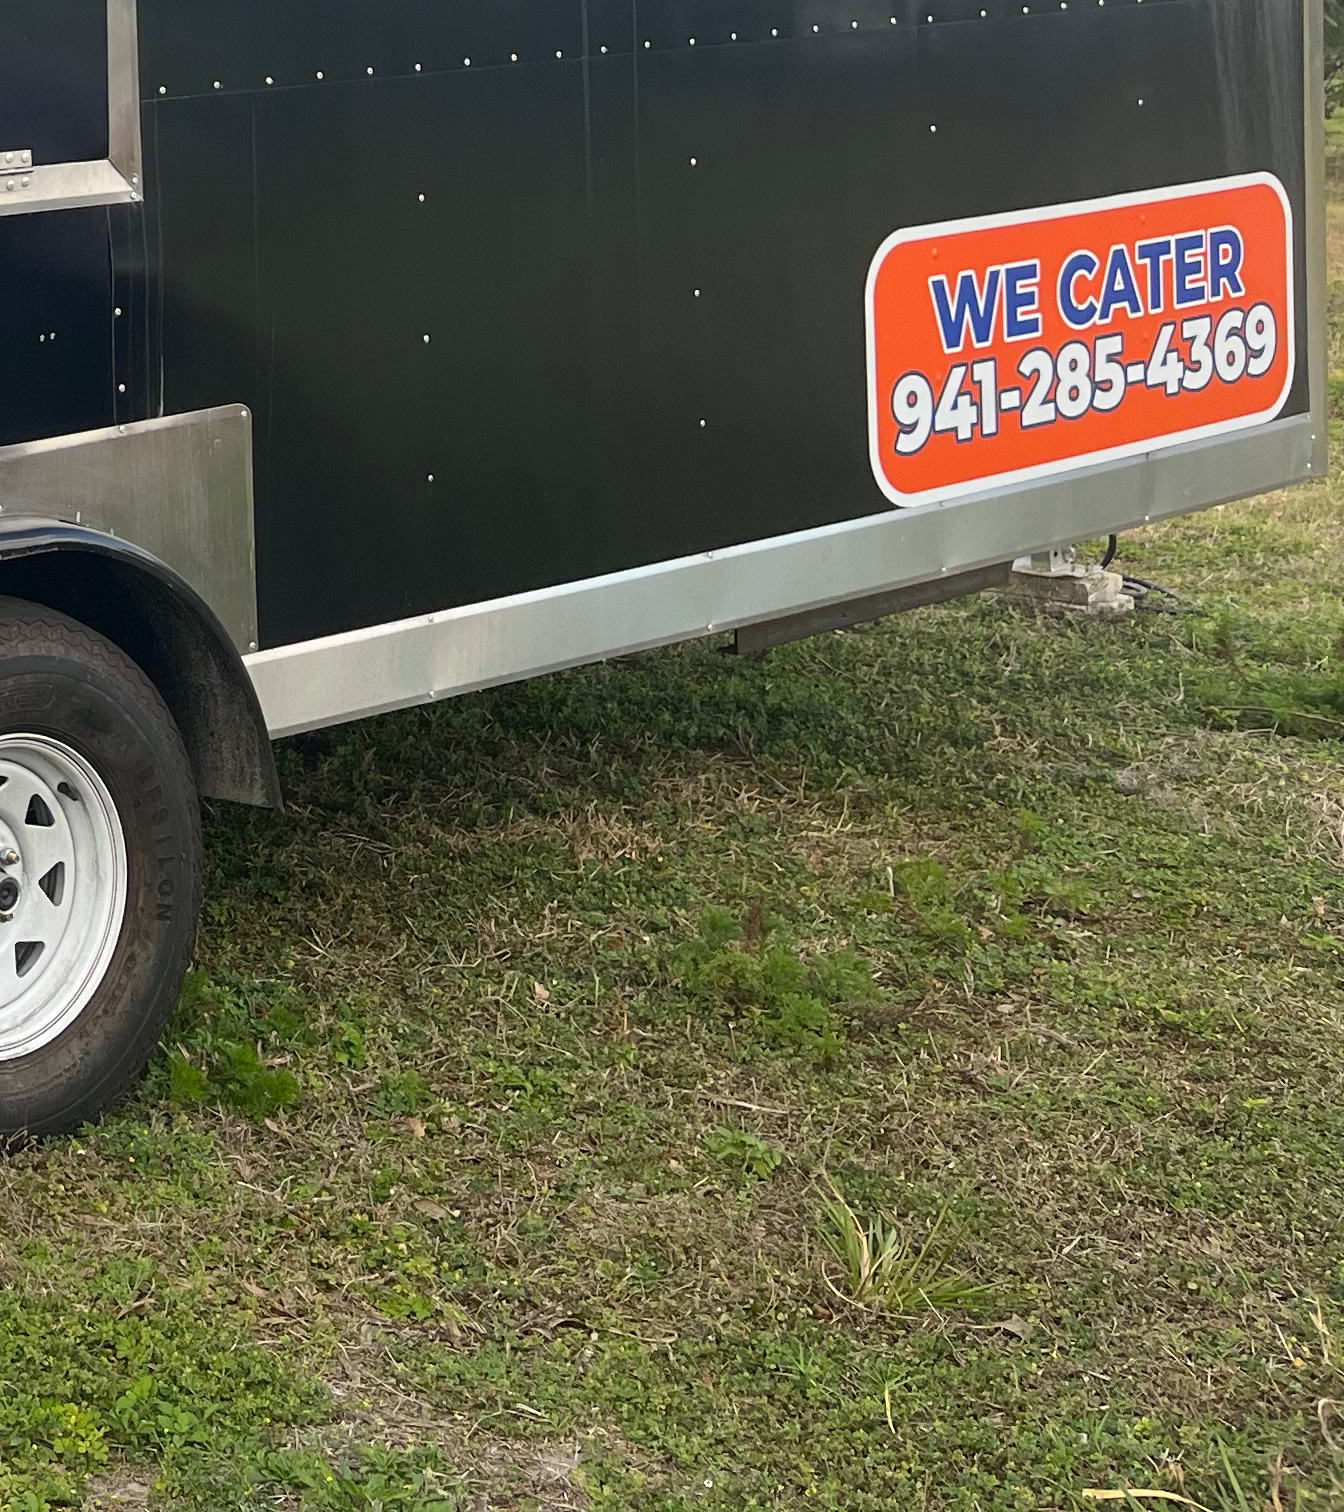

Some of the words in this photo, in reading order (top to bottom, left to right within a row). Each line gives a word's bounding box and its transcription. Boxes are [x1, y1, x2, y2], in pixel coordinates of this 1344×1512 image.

[931, 262, 1041, 350] WE
[1059, 227, 1243, 328] CATER
[892, 302, 1277, 456] 941-285-4369
